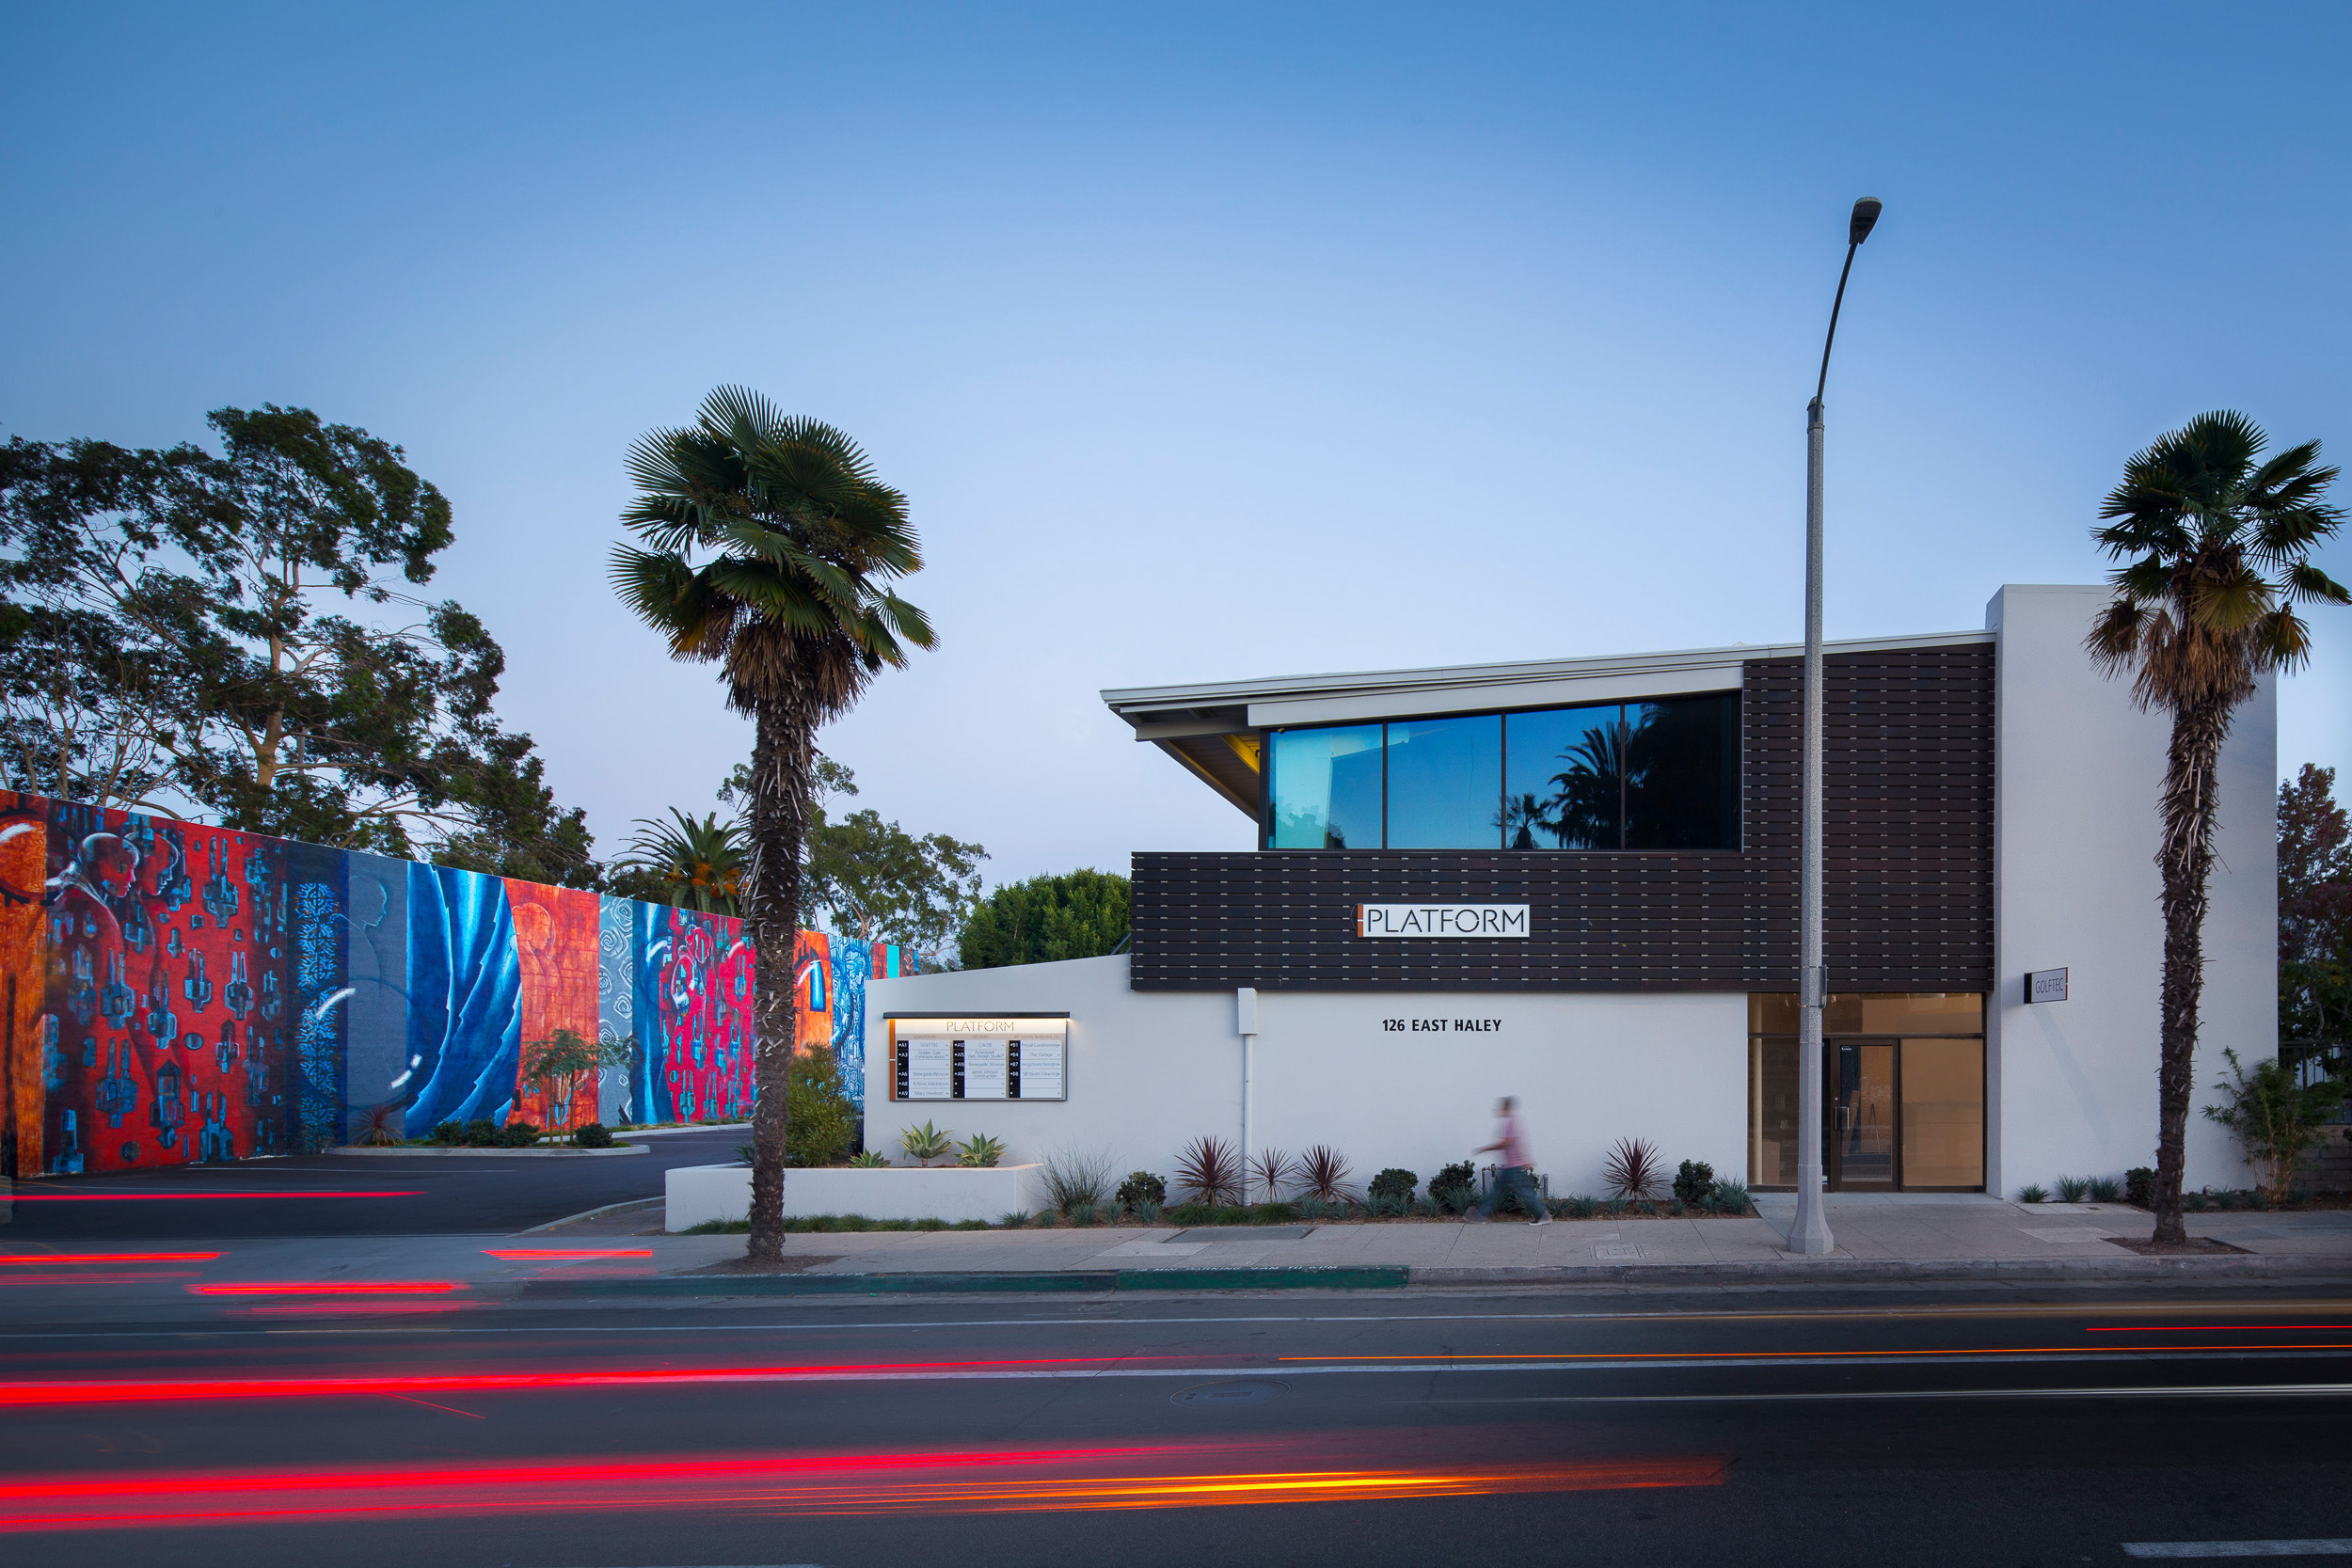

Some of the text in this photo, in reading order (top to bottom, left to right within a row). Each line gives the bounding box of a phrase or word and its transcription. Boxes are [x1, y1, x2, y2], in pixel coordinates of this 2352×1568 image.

[1368, 909, 1524, 933] PLATFORM
[2035, 978, 2064, 994] GOLFTEC
[946, 1021, 1014, 1032] PLATFORM
[1382, 1019, 1502, 1032] 126 EAST HALEY
